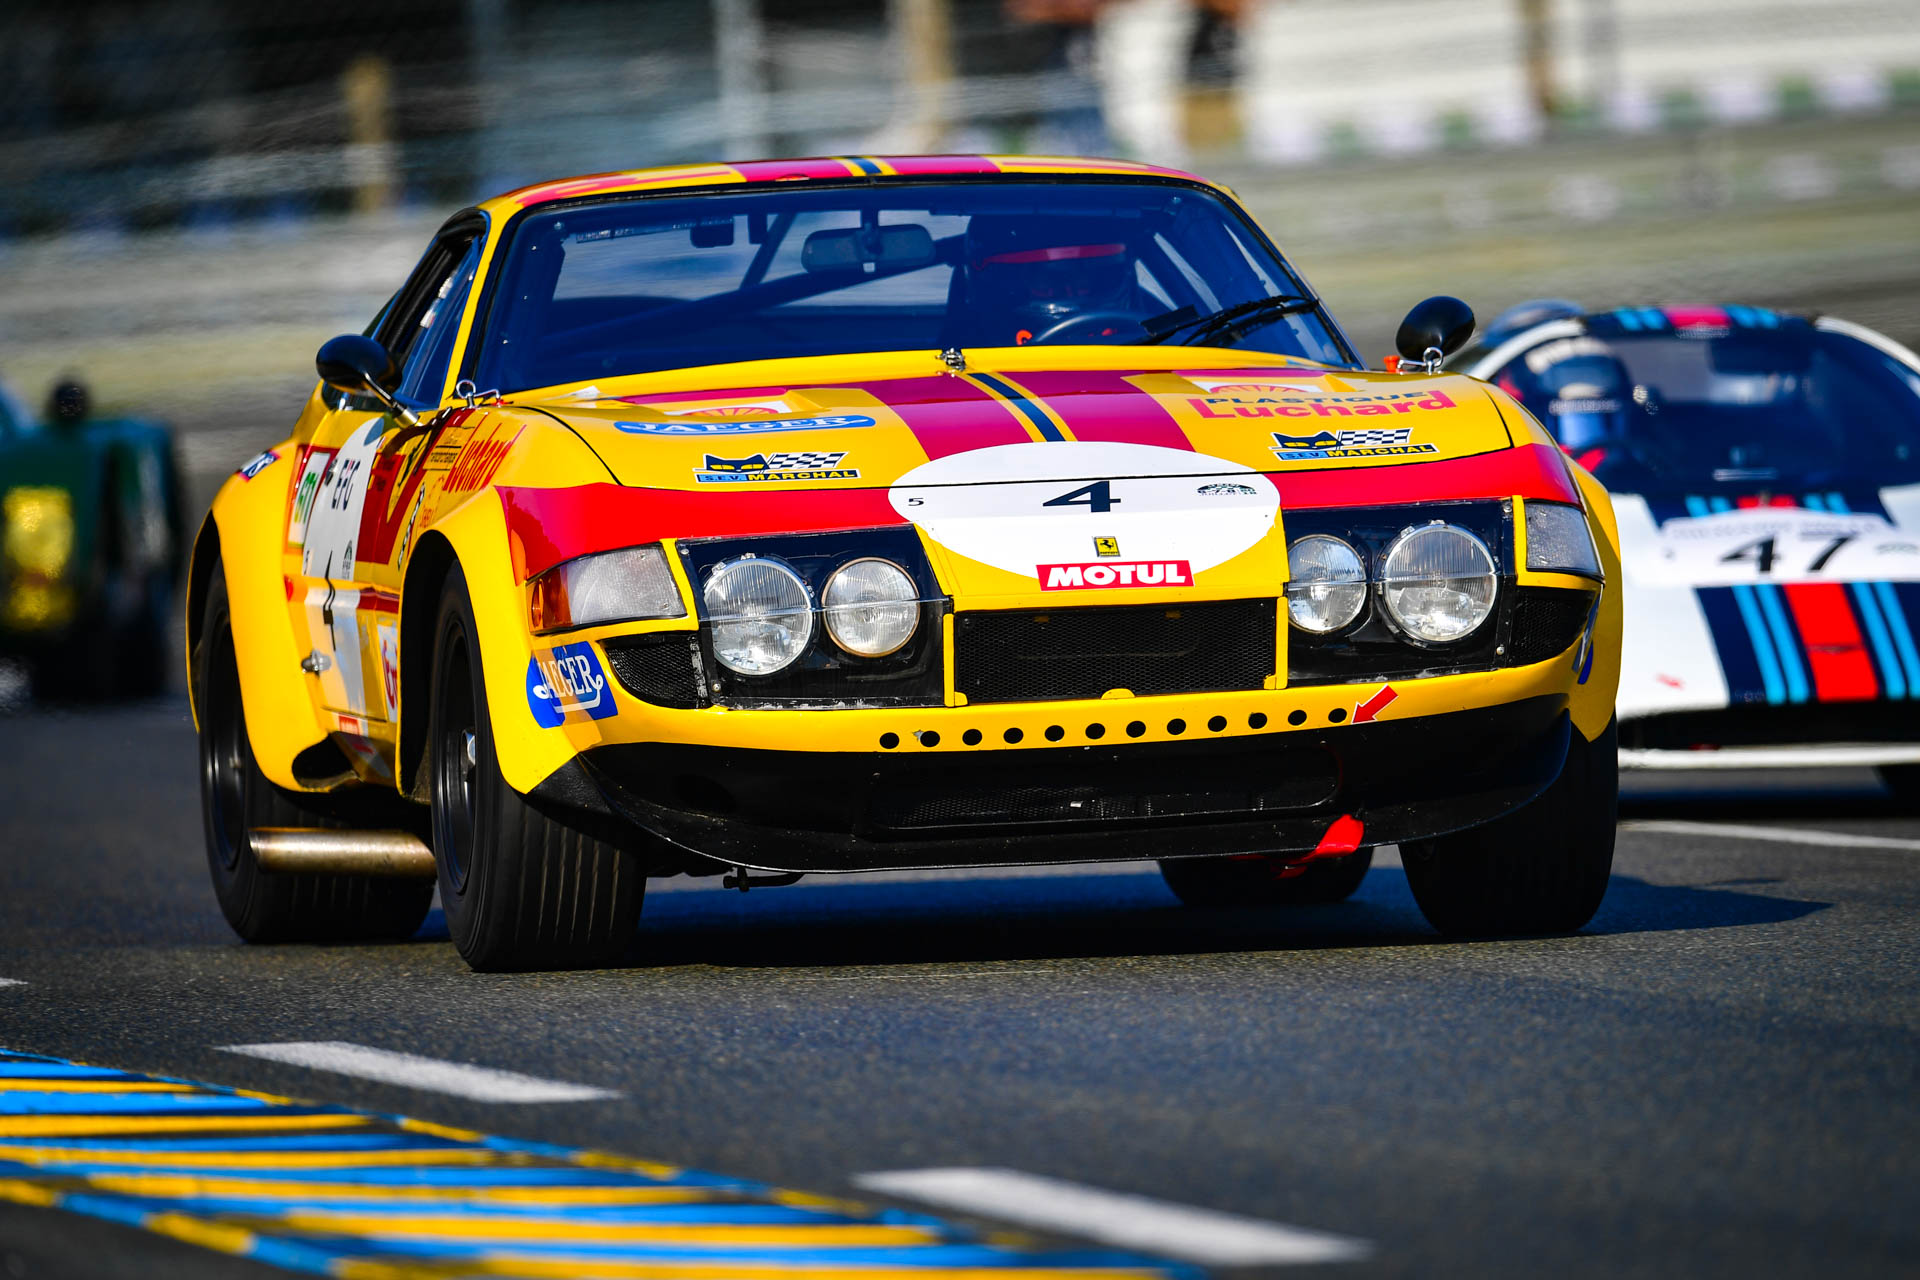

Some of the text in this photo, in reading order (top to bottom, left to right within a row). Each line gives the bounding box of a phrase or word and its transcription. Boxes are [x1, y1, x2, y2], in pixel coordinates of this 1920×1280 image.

[1186, 390, 1457, 418] Luchard
[1205, 391, 1428, 403] PLASTIQUE
[621, 415, 869, 435] JAEGER
[1327, 445, 1434, 457] MARCHAL
[748, 471, 856, 481] MARCHAL
[908, 497, 924, 506] 5
[1042, 480, 1121, 512] 4
[1719, 531, 1858, 575] 47
[1046, 563, 1187, 588] MOTUL
[533, 654, 604, 702] JAEGER
